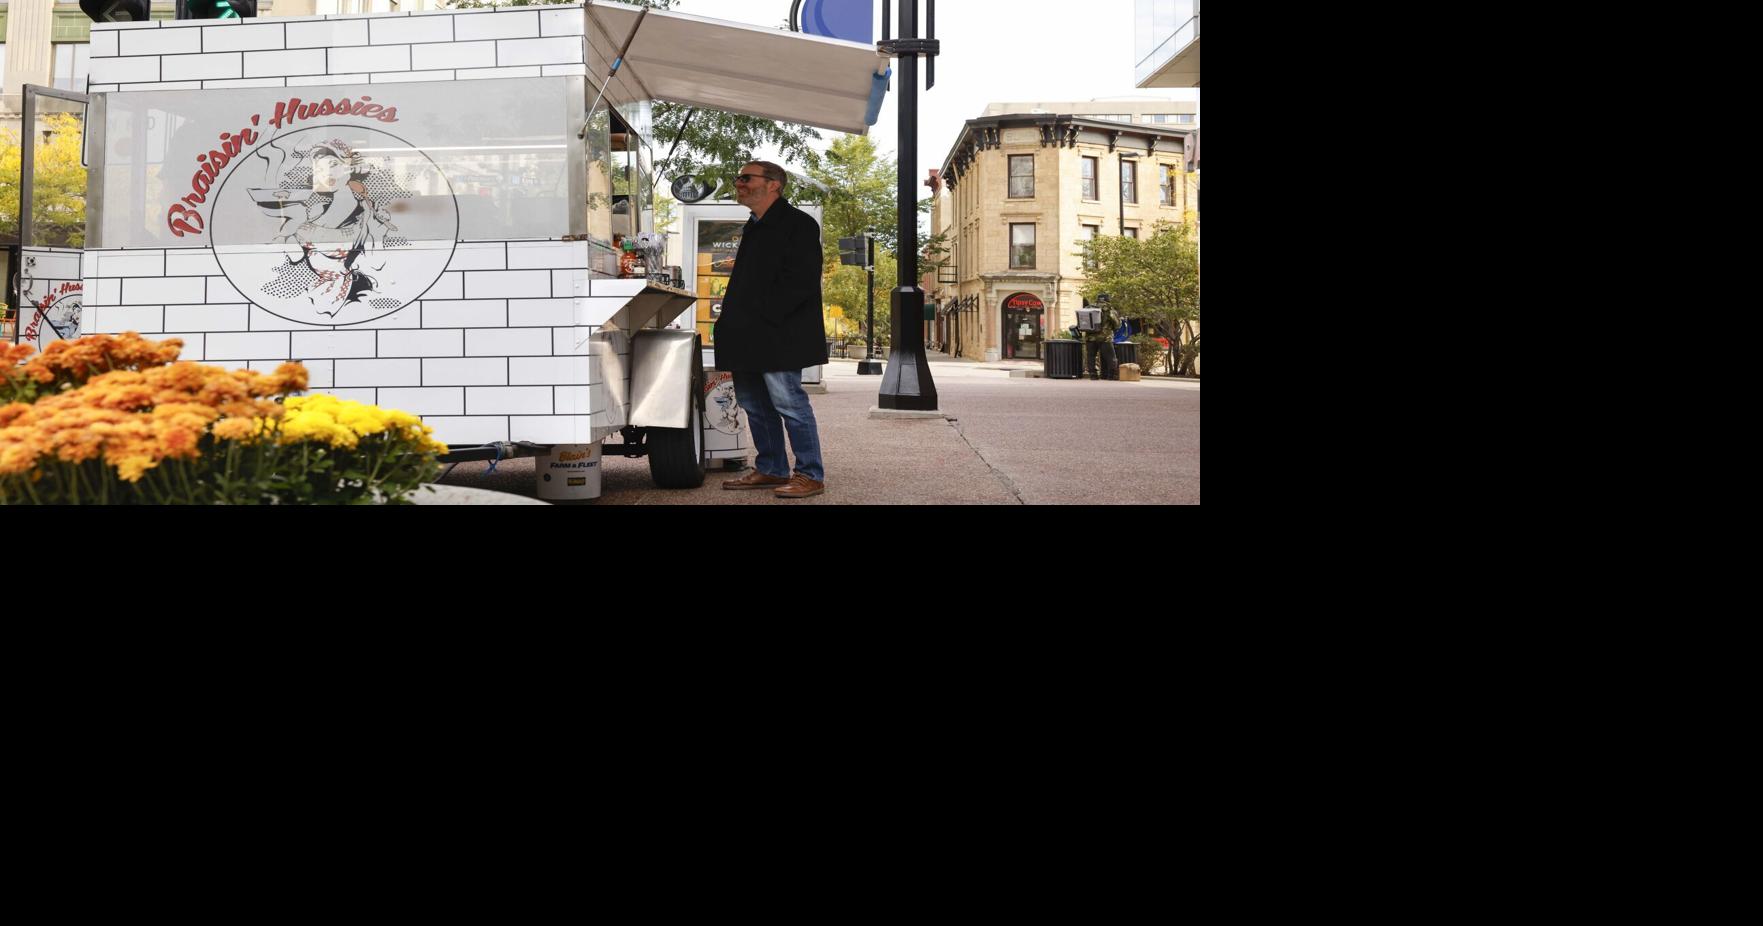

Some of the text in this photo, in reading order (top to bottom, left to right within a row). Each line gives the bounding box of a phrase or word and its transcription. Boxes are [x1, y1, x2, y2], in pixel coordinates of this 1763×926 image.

[167, 96, 399, 237] Braisin' Hussies
[25, 288, 56, 341] Brasin'
